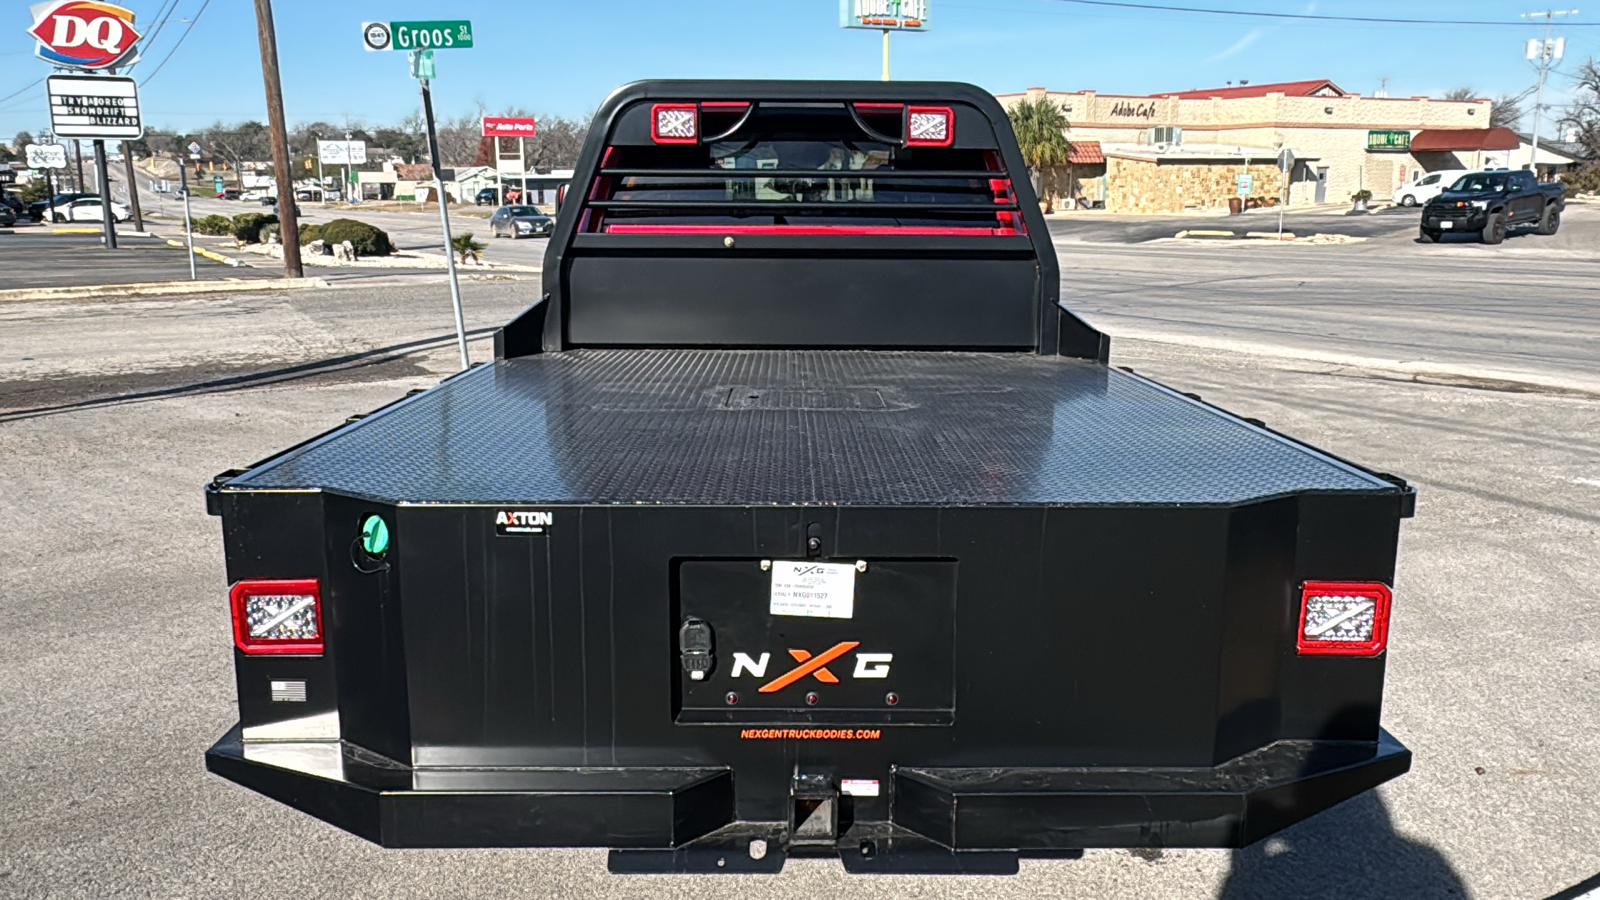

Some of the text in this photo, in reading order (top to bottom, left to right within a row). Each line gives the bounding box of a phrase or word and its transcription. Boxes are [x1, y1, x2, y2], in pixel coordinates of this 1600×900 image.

[51, 15, 123, 54] DQ
[398, 26, 454, 47] Groos
[459, 25, 468, 34] St
[61, 96, 82, 106] TRY
[98, 97, 124, 106] OREO
[68, 106, 126, 116] SNOWDRIFT
[1110, 100, 1136, 117] Adobe
[89, 117, 138, 126] BLIZZARD
[495, 123, 514, 131] Auto
[514, 123, 534, 131] Parts
[496, 511, 553, 525] AXTON
[793, 565, 826, 576] NXG
[793, 591, 828, 599] NXG011527
[731, 641, 893, 693] NXG
[741, 729, 881, 740] NEXGENTRUCKBODIES.COM
